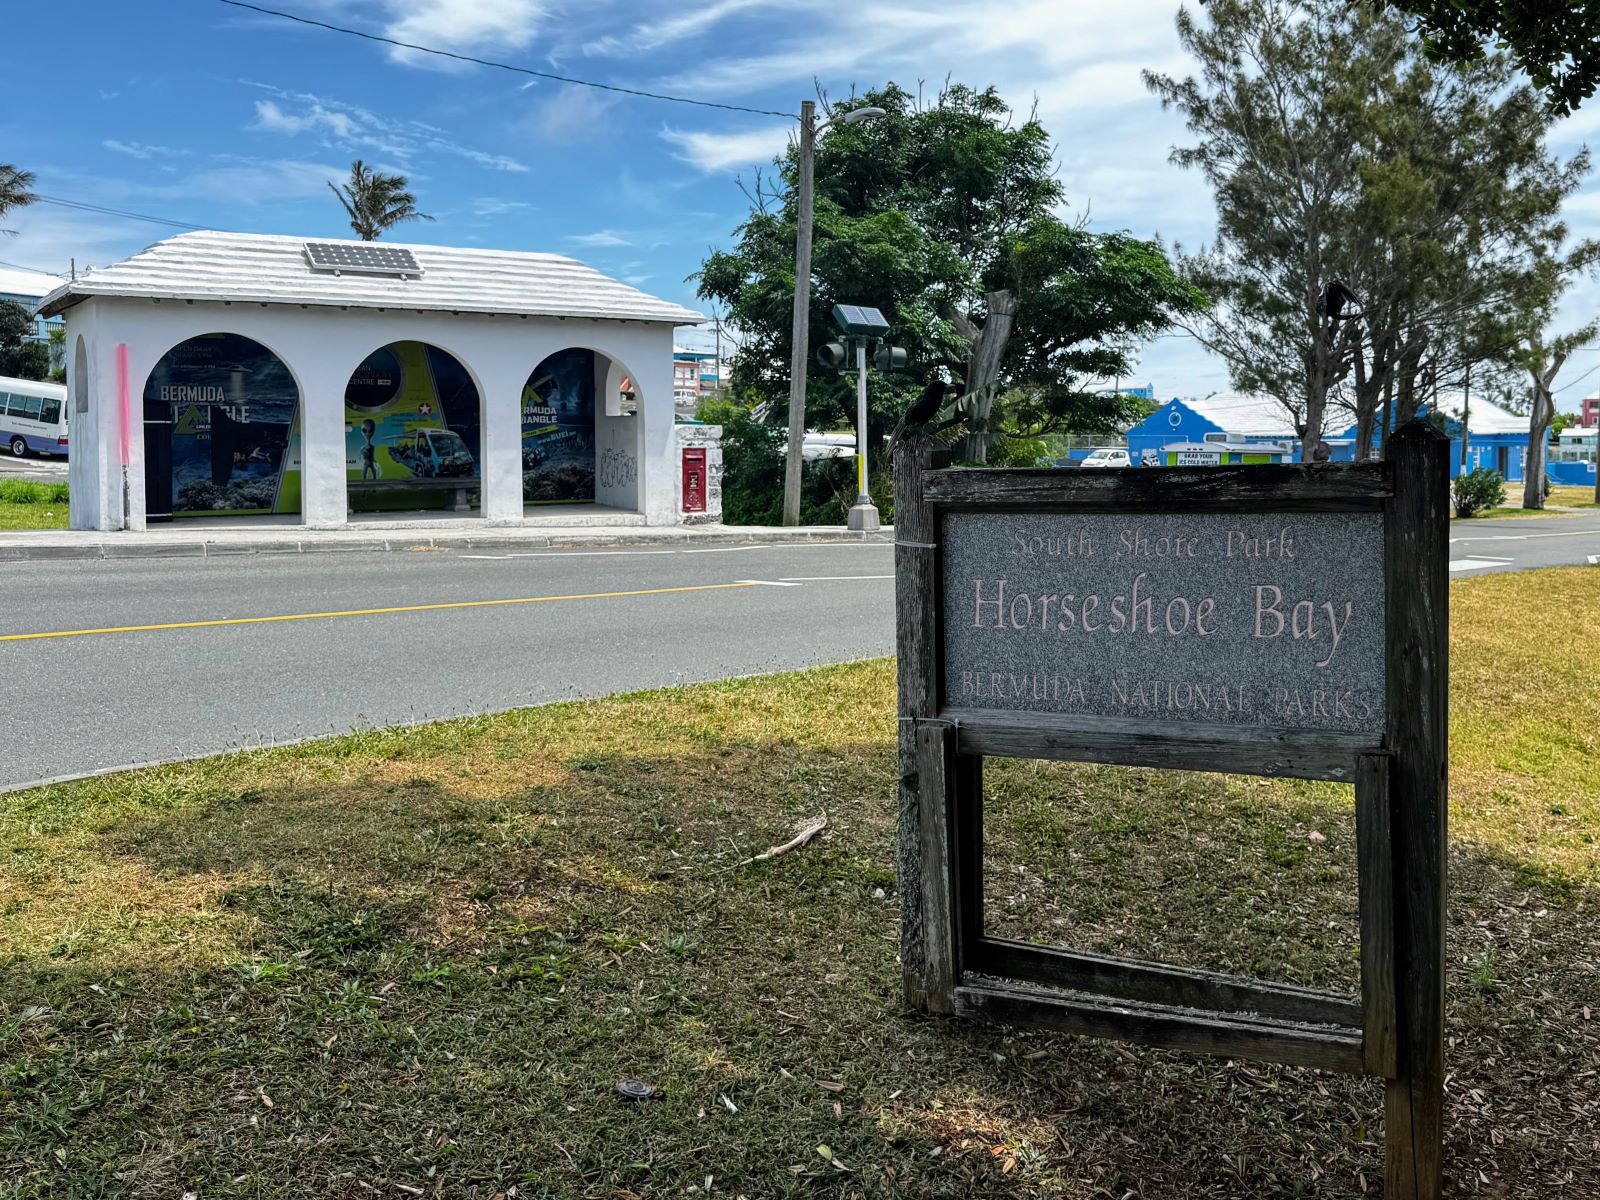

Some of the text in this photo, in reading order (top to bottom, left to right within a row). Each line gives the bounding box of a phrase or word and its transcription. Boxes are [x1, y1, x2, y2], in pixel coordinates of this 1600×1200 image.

[160, 385, 225, 402] BERMUDA
[521, 406, 557, 415] RMUDA
[521, 415, 558, 424] IANGLE
[1013, 525, 1295, 557] South Shore Park
[970, 571, 1352, 667] Horseshoe Bay
[961, 670, 1371, 720] BERMUDA NATIONAL PARKS
